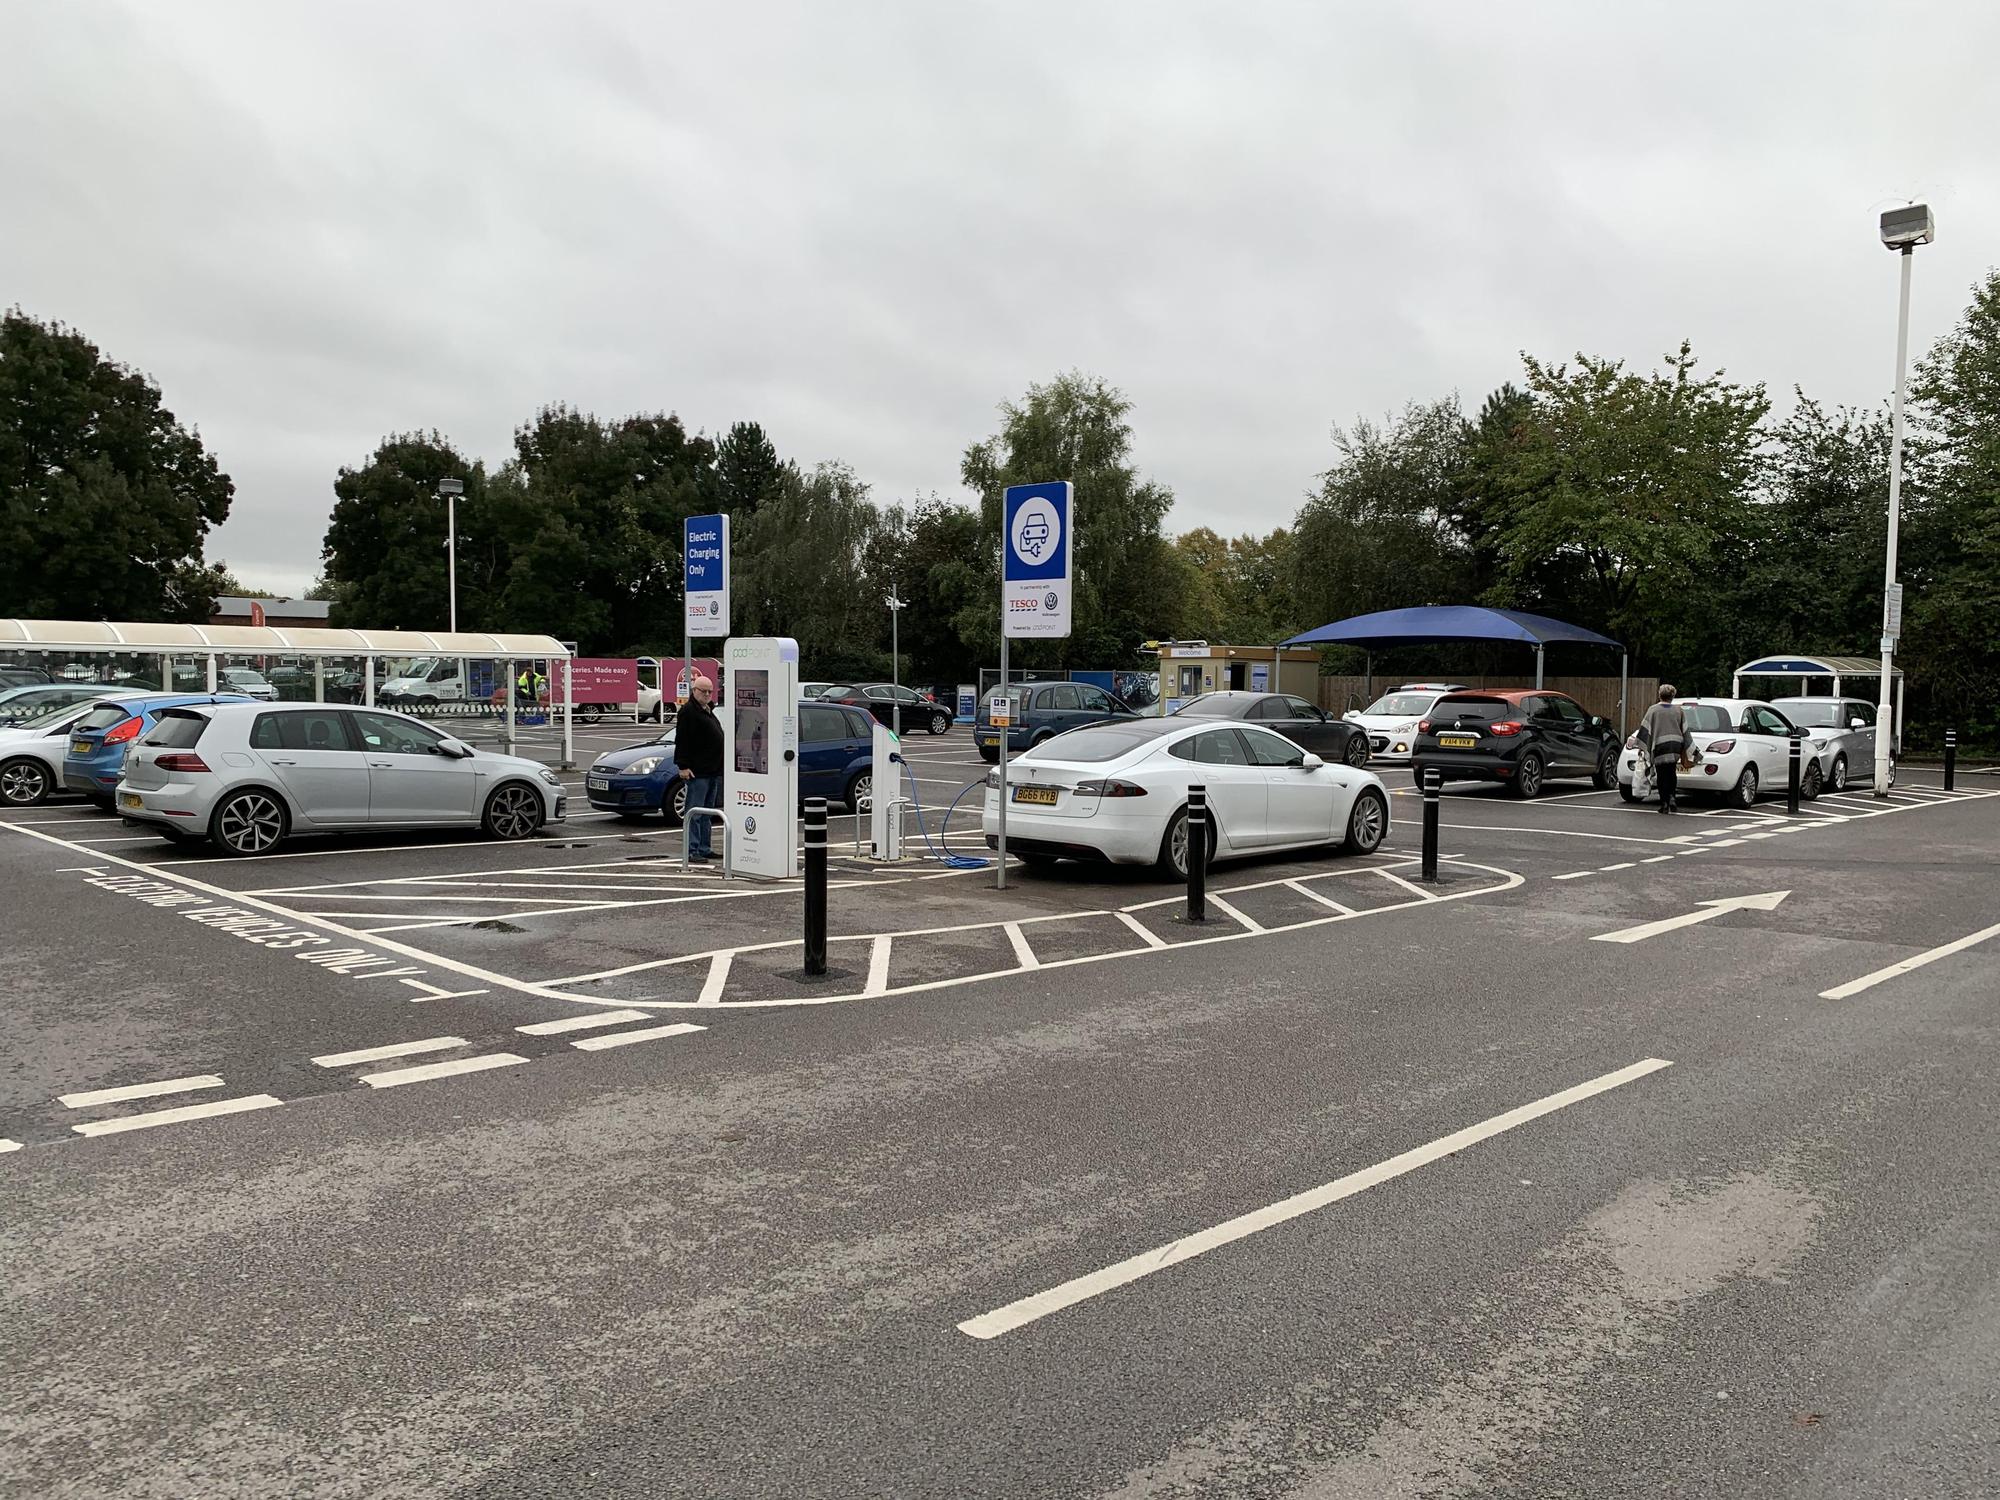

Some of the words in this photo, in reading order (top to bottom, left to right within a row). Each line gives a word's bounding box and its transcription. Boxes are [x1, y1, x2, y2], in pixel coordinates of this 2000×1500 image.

[689, 531, 716, 542] Electric
[689, 548, 720, 560] Charging
[689, 565, 705, 576] Only
[1009, 600, 1038, 608] TESCO
[560, 666, 593, 674] Gceries.
[594, 666, 612, 674] Made
[613, 667, 629, 675] easy.
[737, 791, 765, 802] TESCO
[1017, 789, 1038, 800] BG66
[1039, 791, 1056, 801] RYB
[83, 875, 213, 907] ELECTRIC
[178, 905, 331, 950] VEHICLES
[294, 947, 428, 980] ONLY
